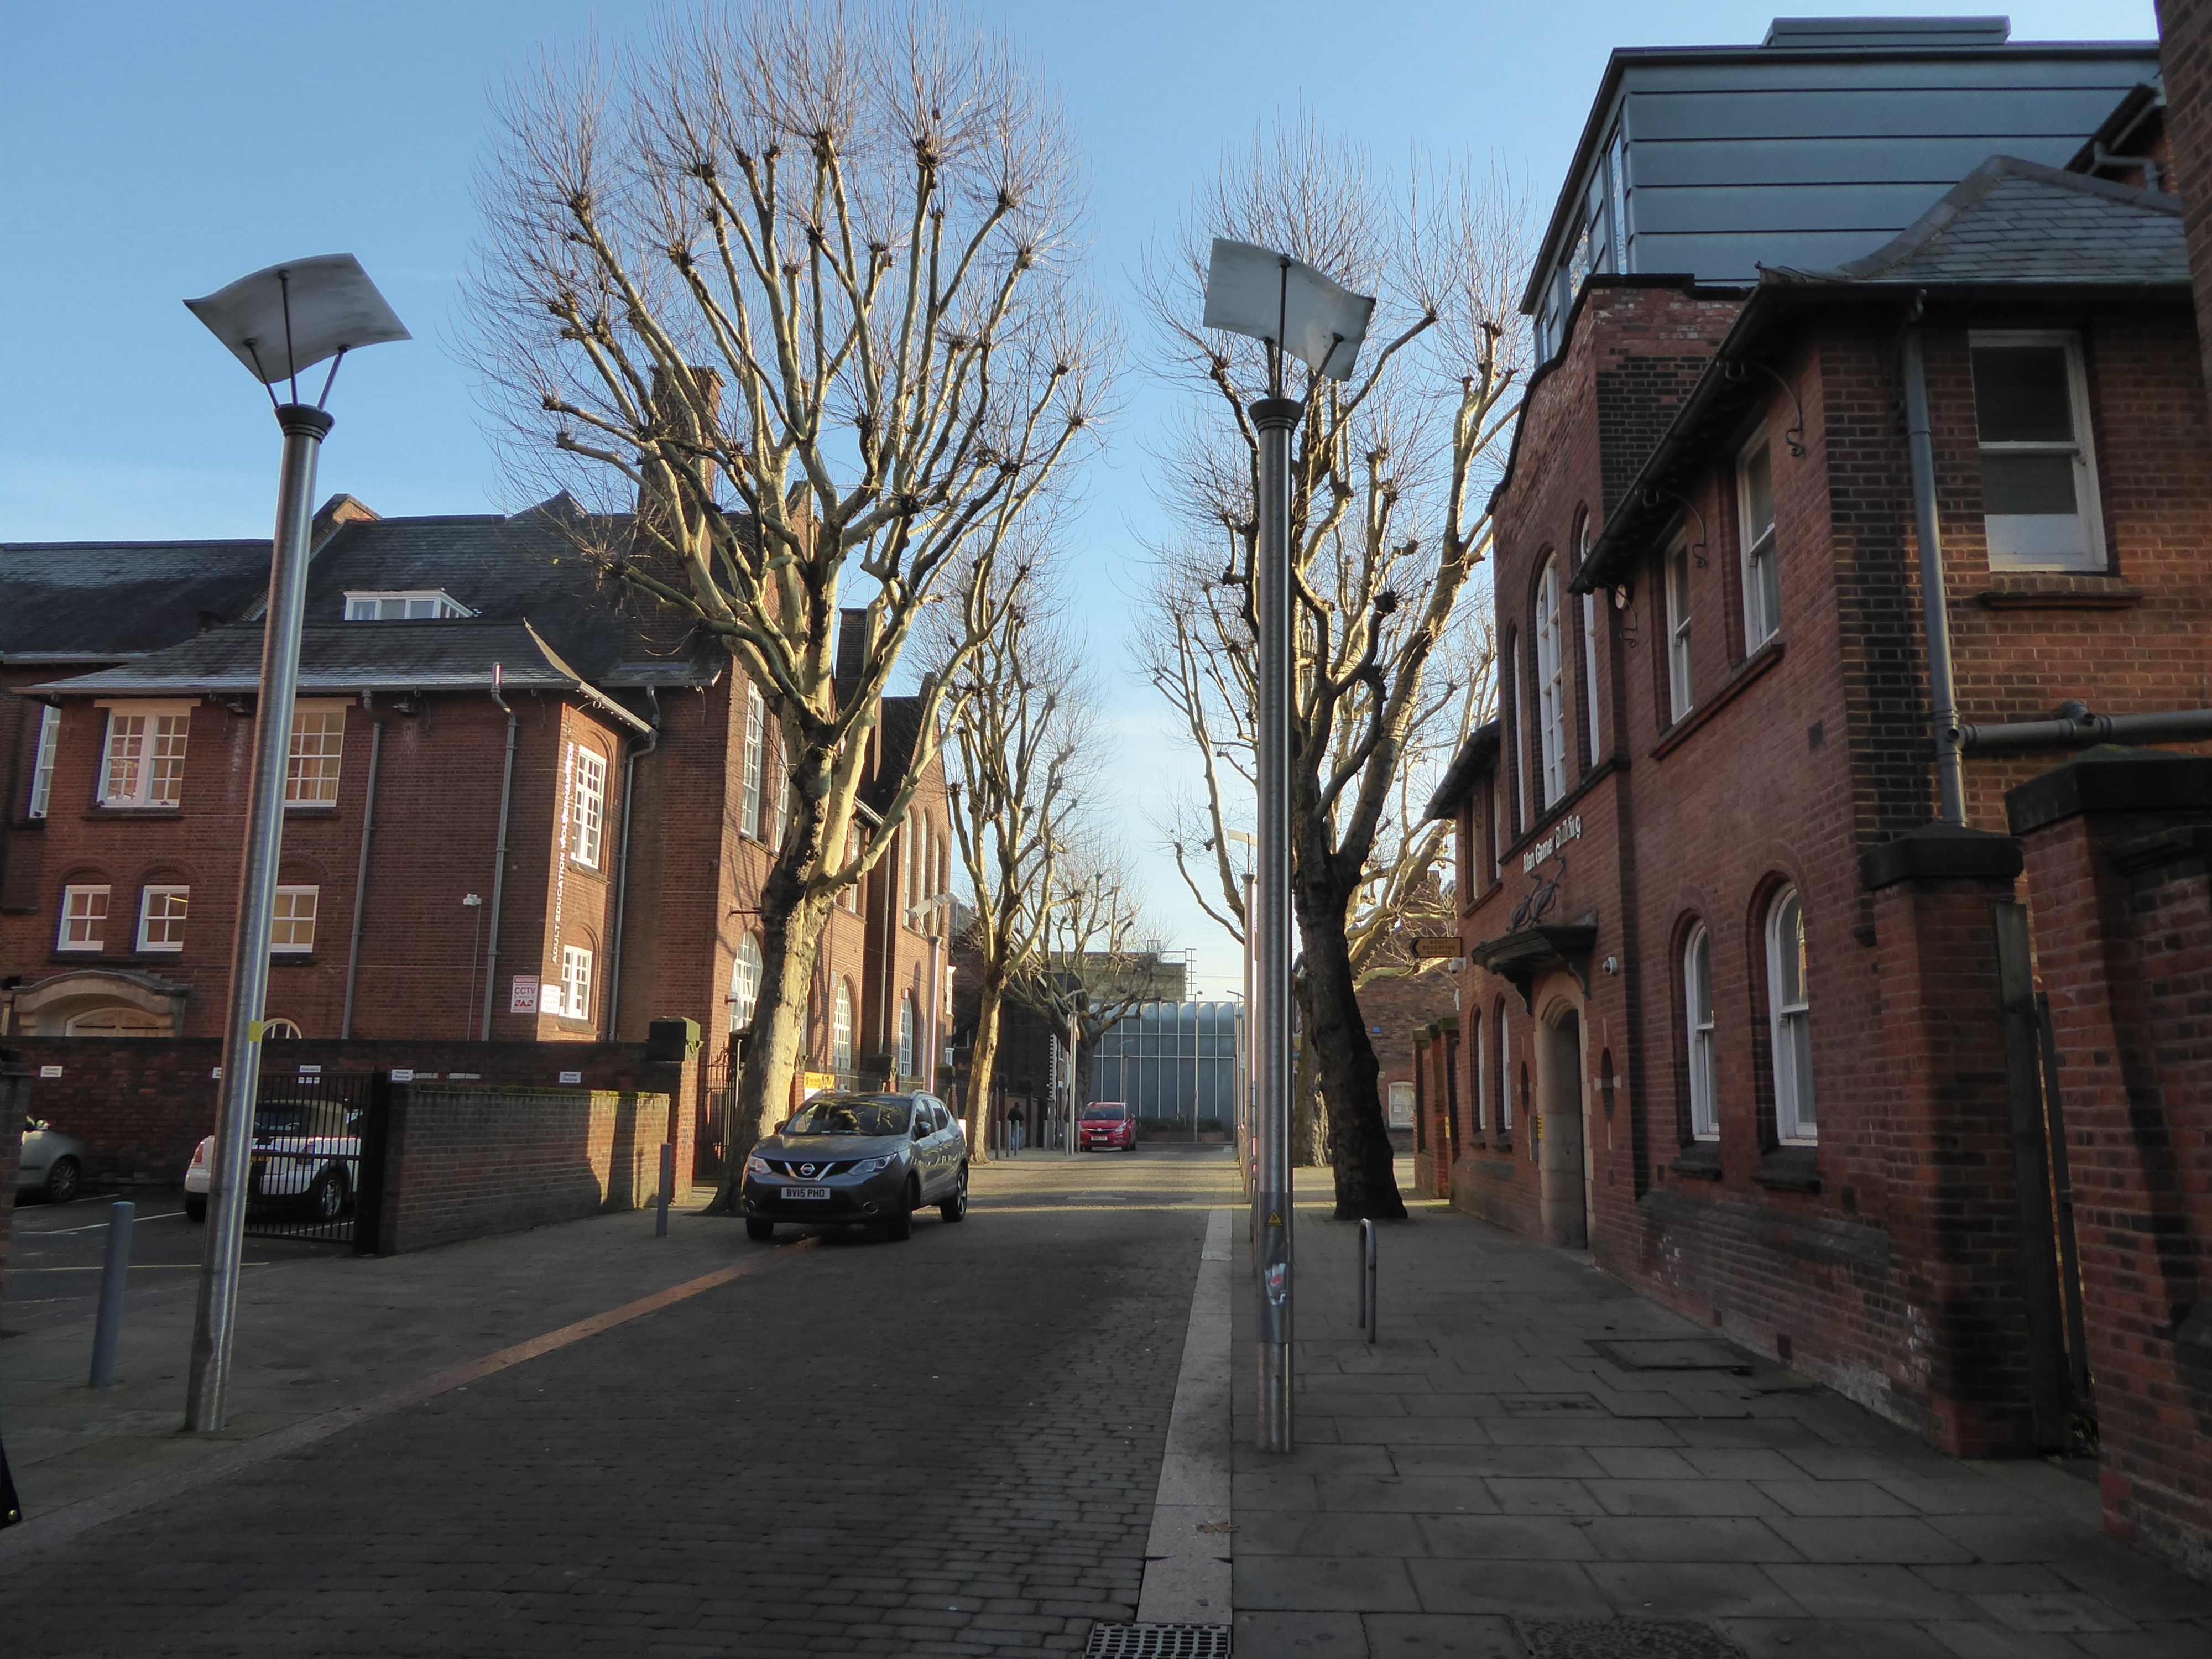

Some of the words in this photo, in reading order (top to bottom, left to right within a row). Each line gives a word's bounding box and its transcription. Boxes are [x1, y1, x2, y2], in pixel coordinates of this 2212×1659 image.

[560, 741, 574, 849] WOLVERHAMPTON
[1523, 852, 1535, 874] Alan
[1555, 815, 1580, 849] Building
[555, 852, 565, 922] EDUCATION
[552, 925, 560, 963] ADULT
[786, 1188, 805, 1197] BV15
[807, 1189, 825, 1197] PHO
